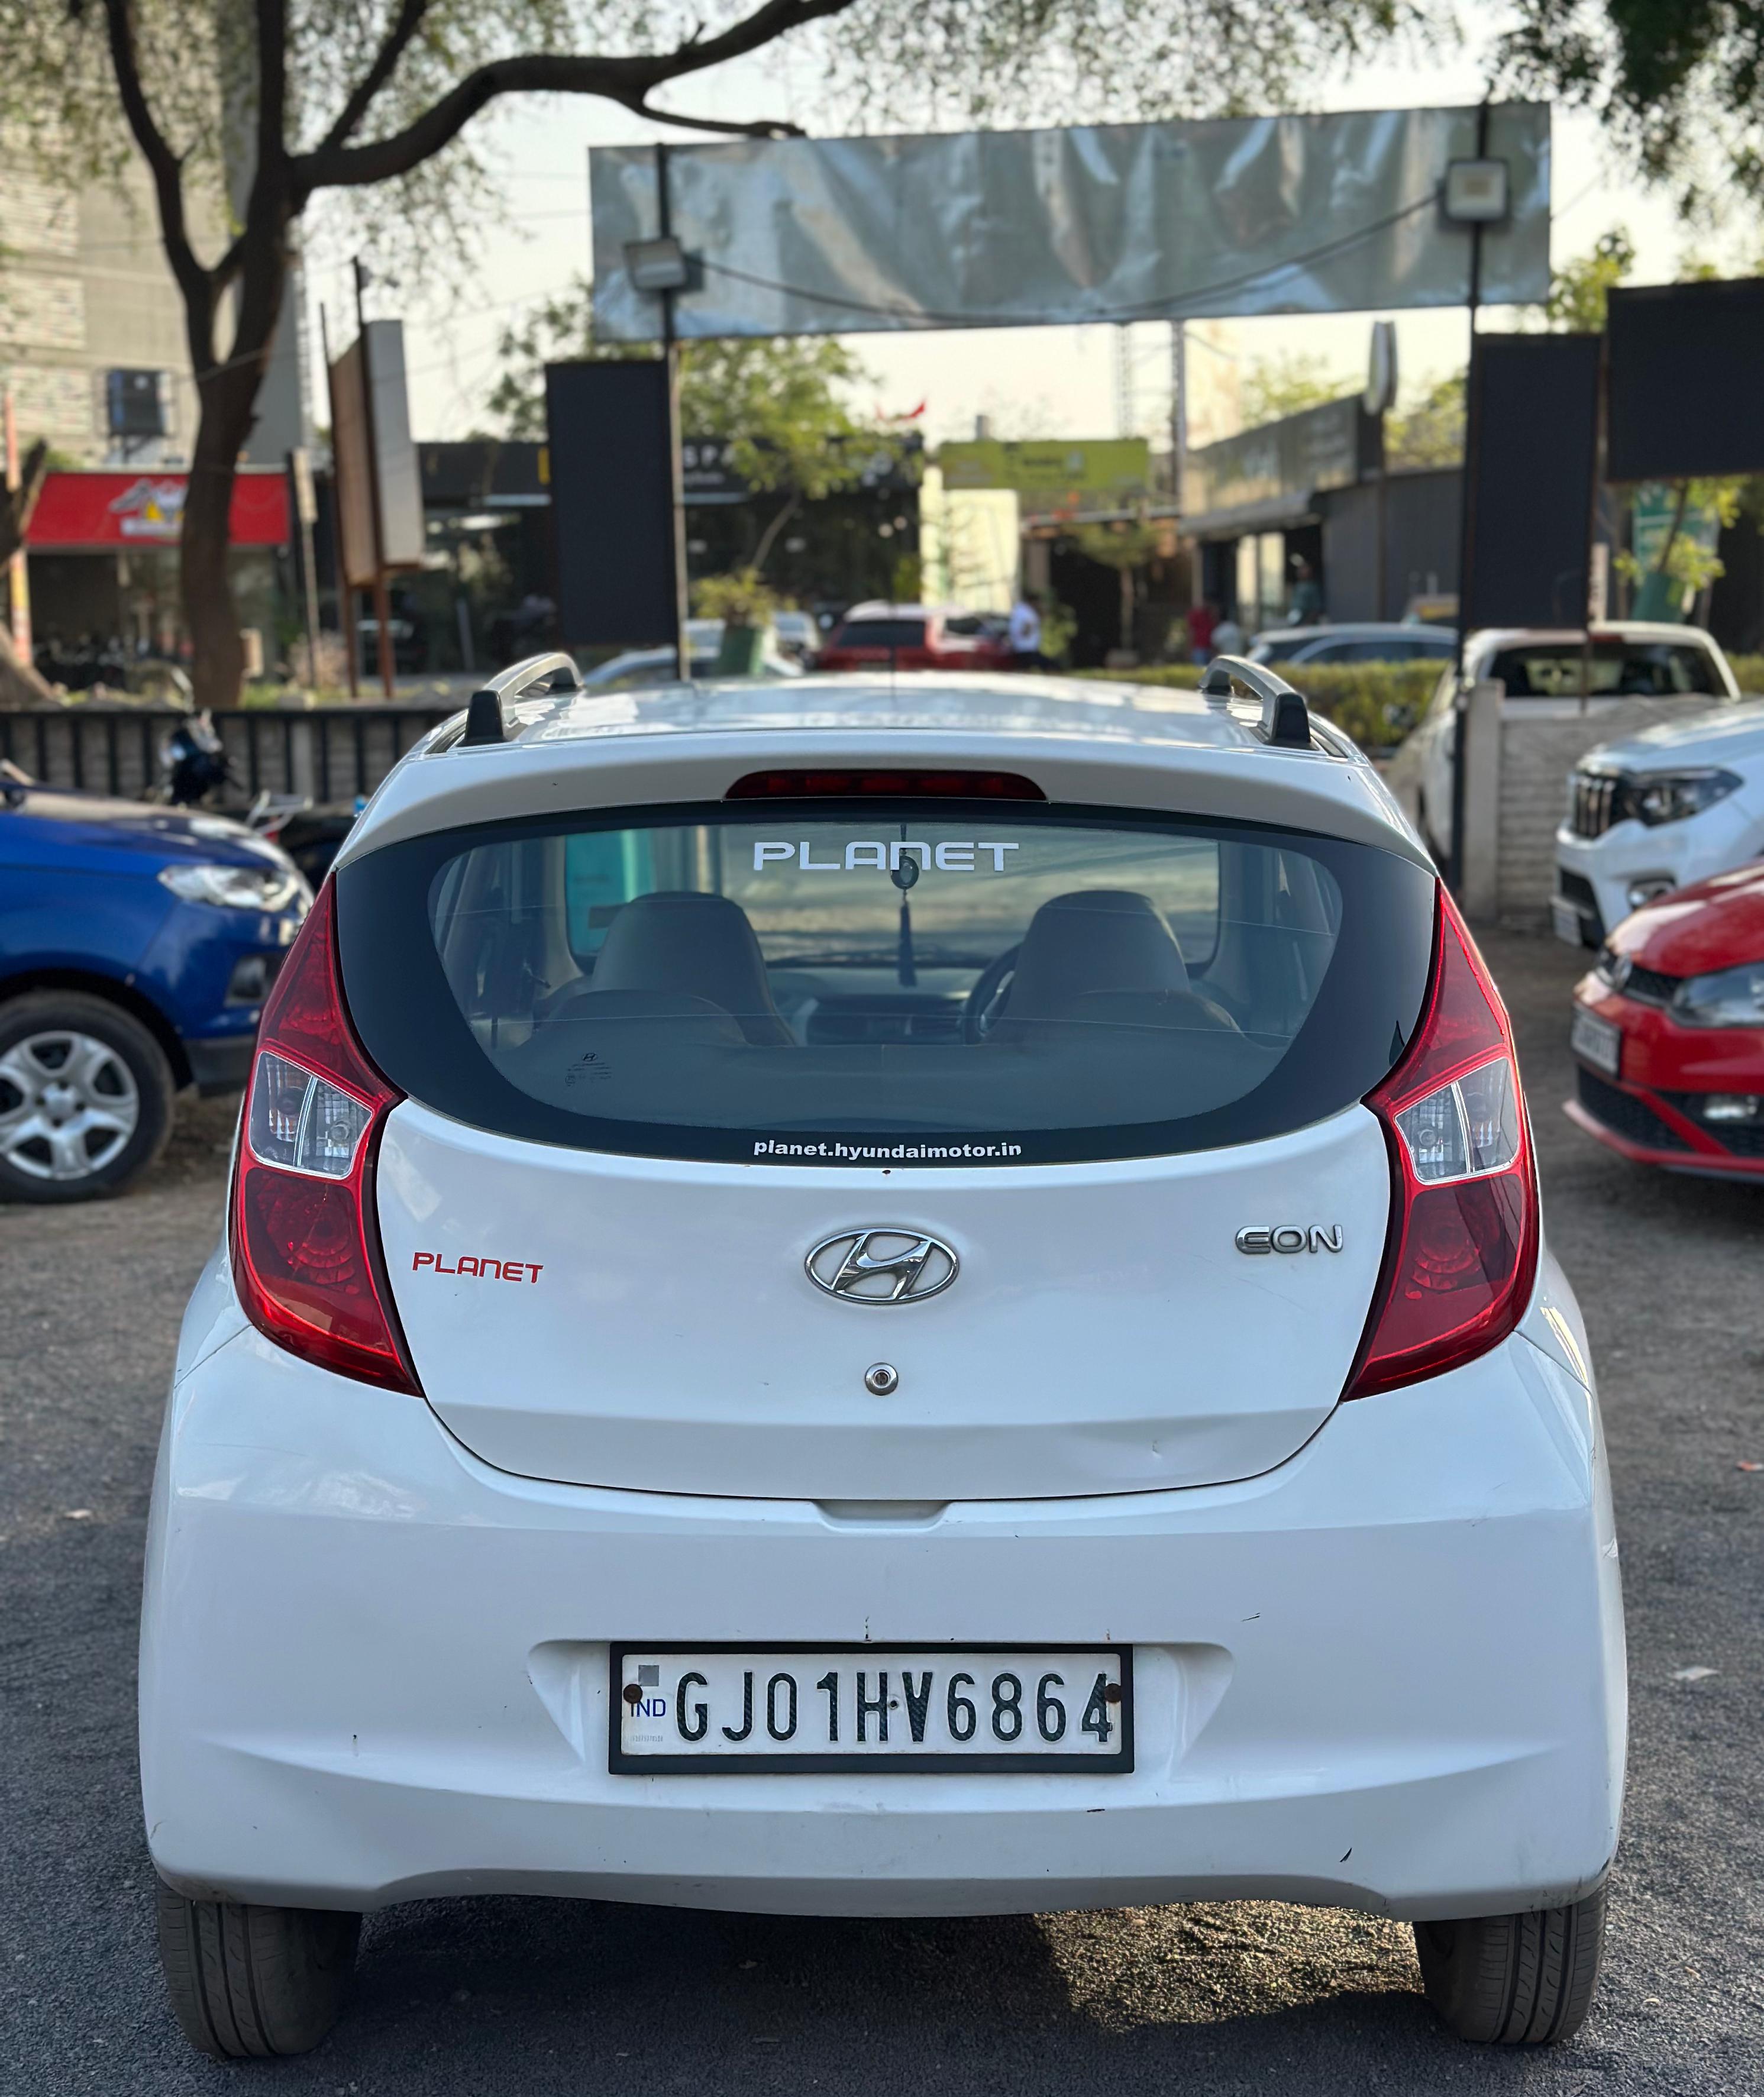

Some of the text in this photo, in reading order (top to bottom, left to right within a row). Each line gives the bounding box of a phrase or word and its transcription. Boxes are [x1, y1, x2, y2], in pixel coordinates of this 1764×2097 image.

[754, 841, 1019, 871] PLANET
[753, 1139, 1022, 1161] planet.hyundaimotor.in
[1235, 1224, 1343, 1255] EON
[412, 1252, 544, 1284] PLANET
[631, 1698, 666, 1717] IND
[676, 1671, 1113, 1742] GJ01HV6864
